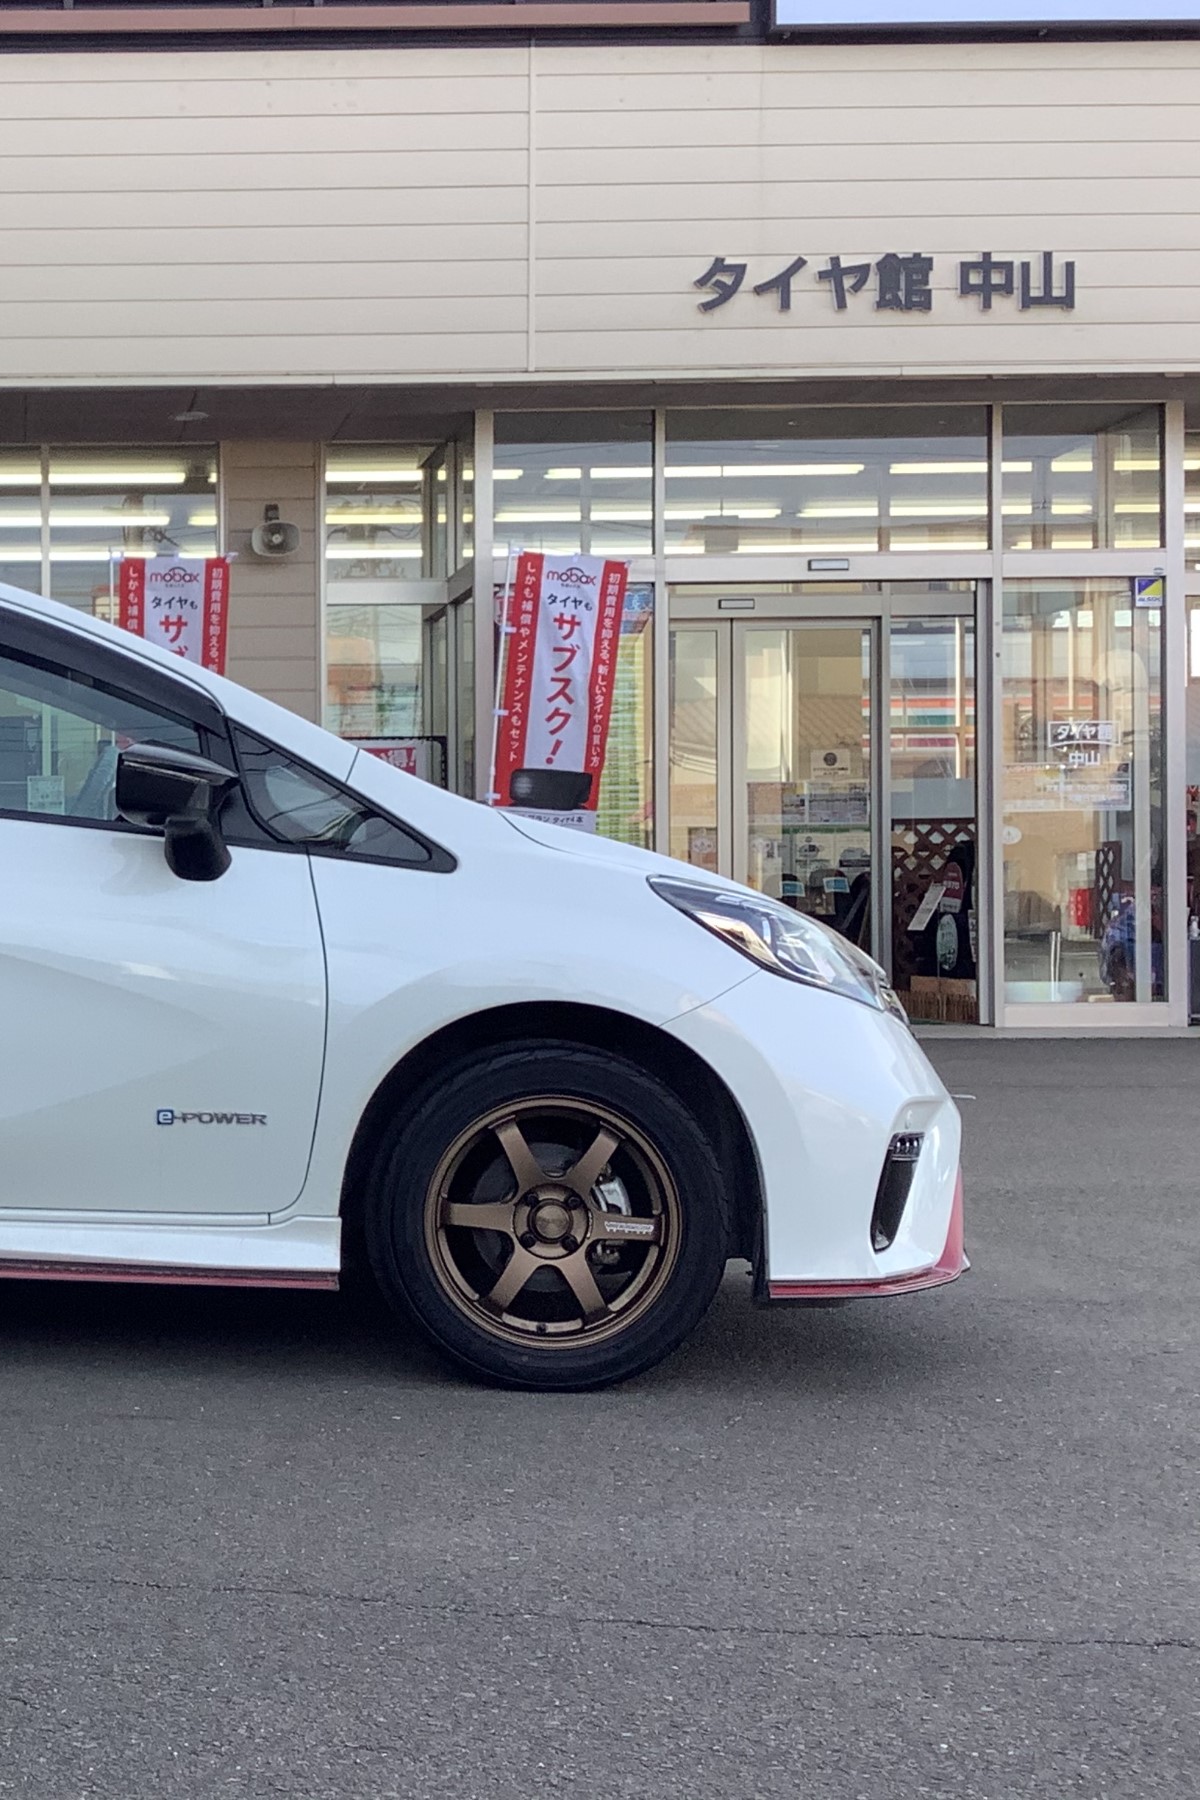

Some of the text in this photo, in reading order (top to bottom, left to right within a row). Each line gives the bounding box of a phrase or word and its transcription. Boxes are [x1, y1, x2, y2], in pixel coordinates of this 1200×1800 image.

[693, 251, 1076, 313] タイヤ館 中山
[152, 596, 198, 609] タイヤも
[547, 593, 593, 611] タイヤも
[508, 561, 537, 762] しかも補償やメンテナンスもセット
[1056, 723, 1114, 740] タイヤ館
[1068, 750, 1101, 767] 中山
[157, 1109, 267, 1126] e-POWER
